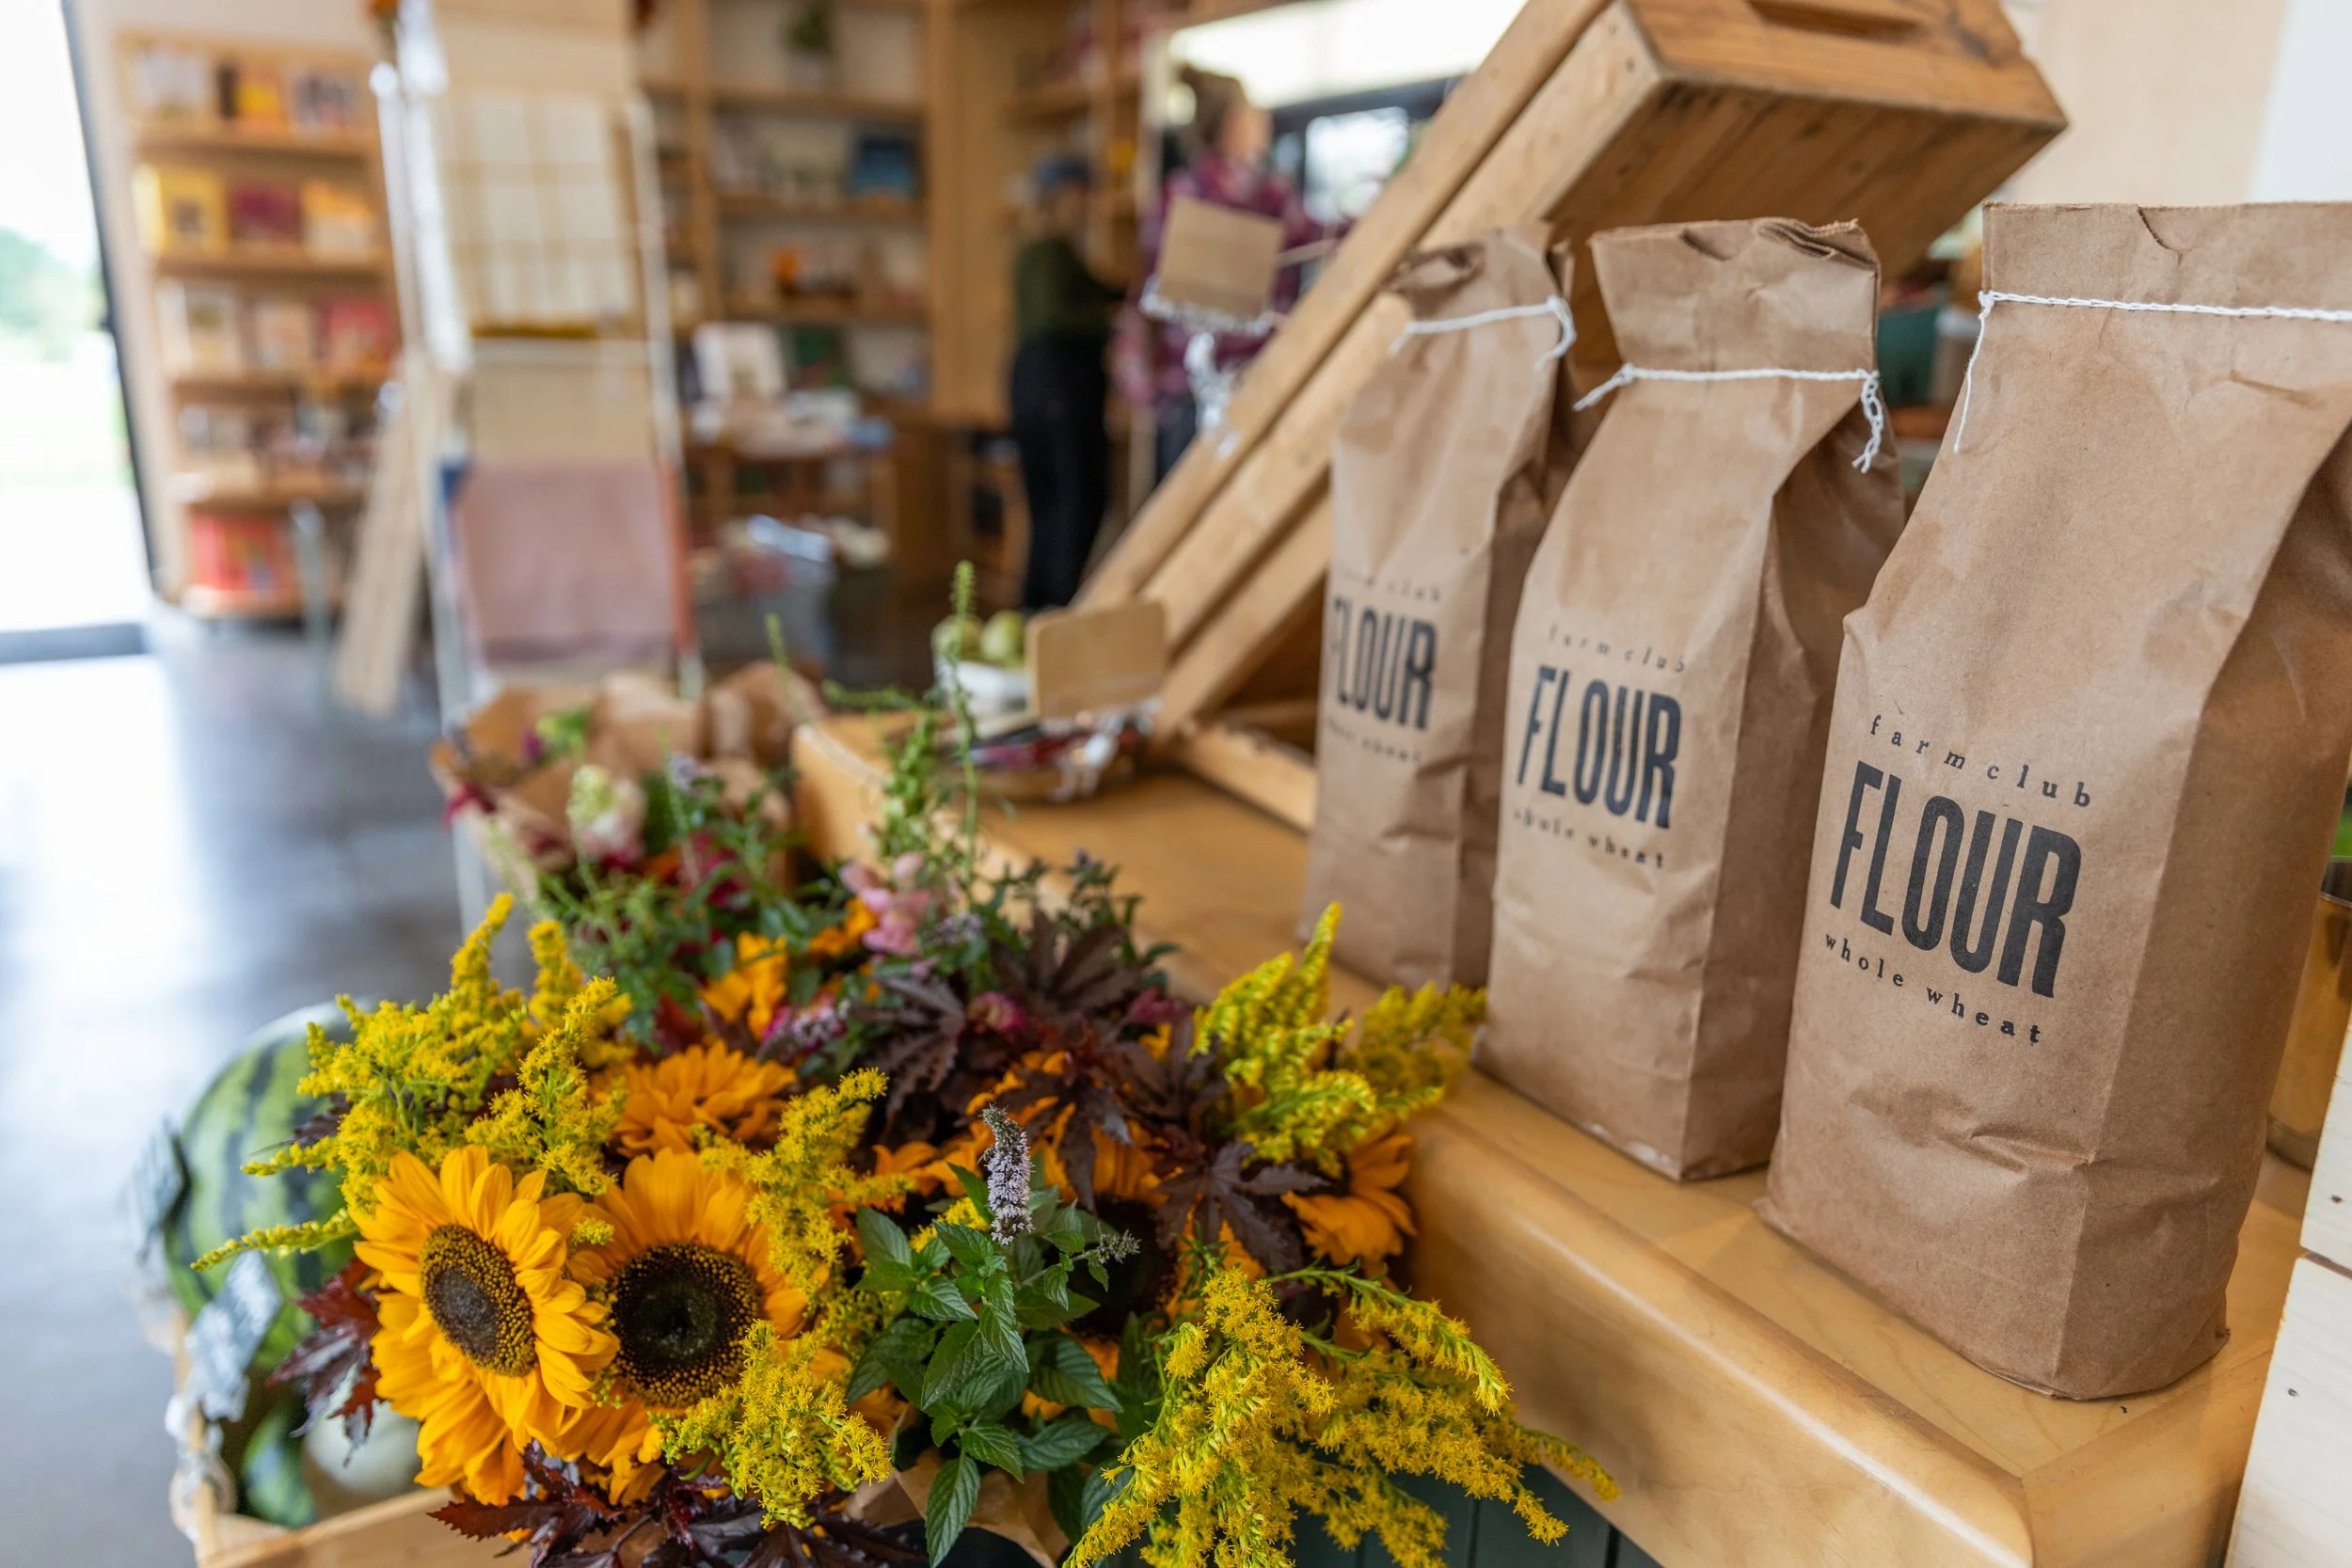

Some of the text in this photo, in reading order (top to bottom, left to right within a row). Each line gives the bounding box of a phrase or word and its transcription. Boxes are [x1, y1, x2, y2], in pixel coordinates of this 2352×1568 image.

[1328, 596, 1438, 731] FLOUR
[1517, 664, 1682, 830] FLOUR
[1830, 760, 2082, 998] FLOUR
[1825, 933, 2041, 1044] whole wheat
